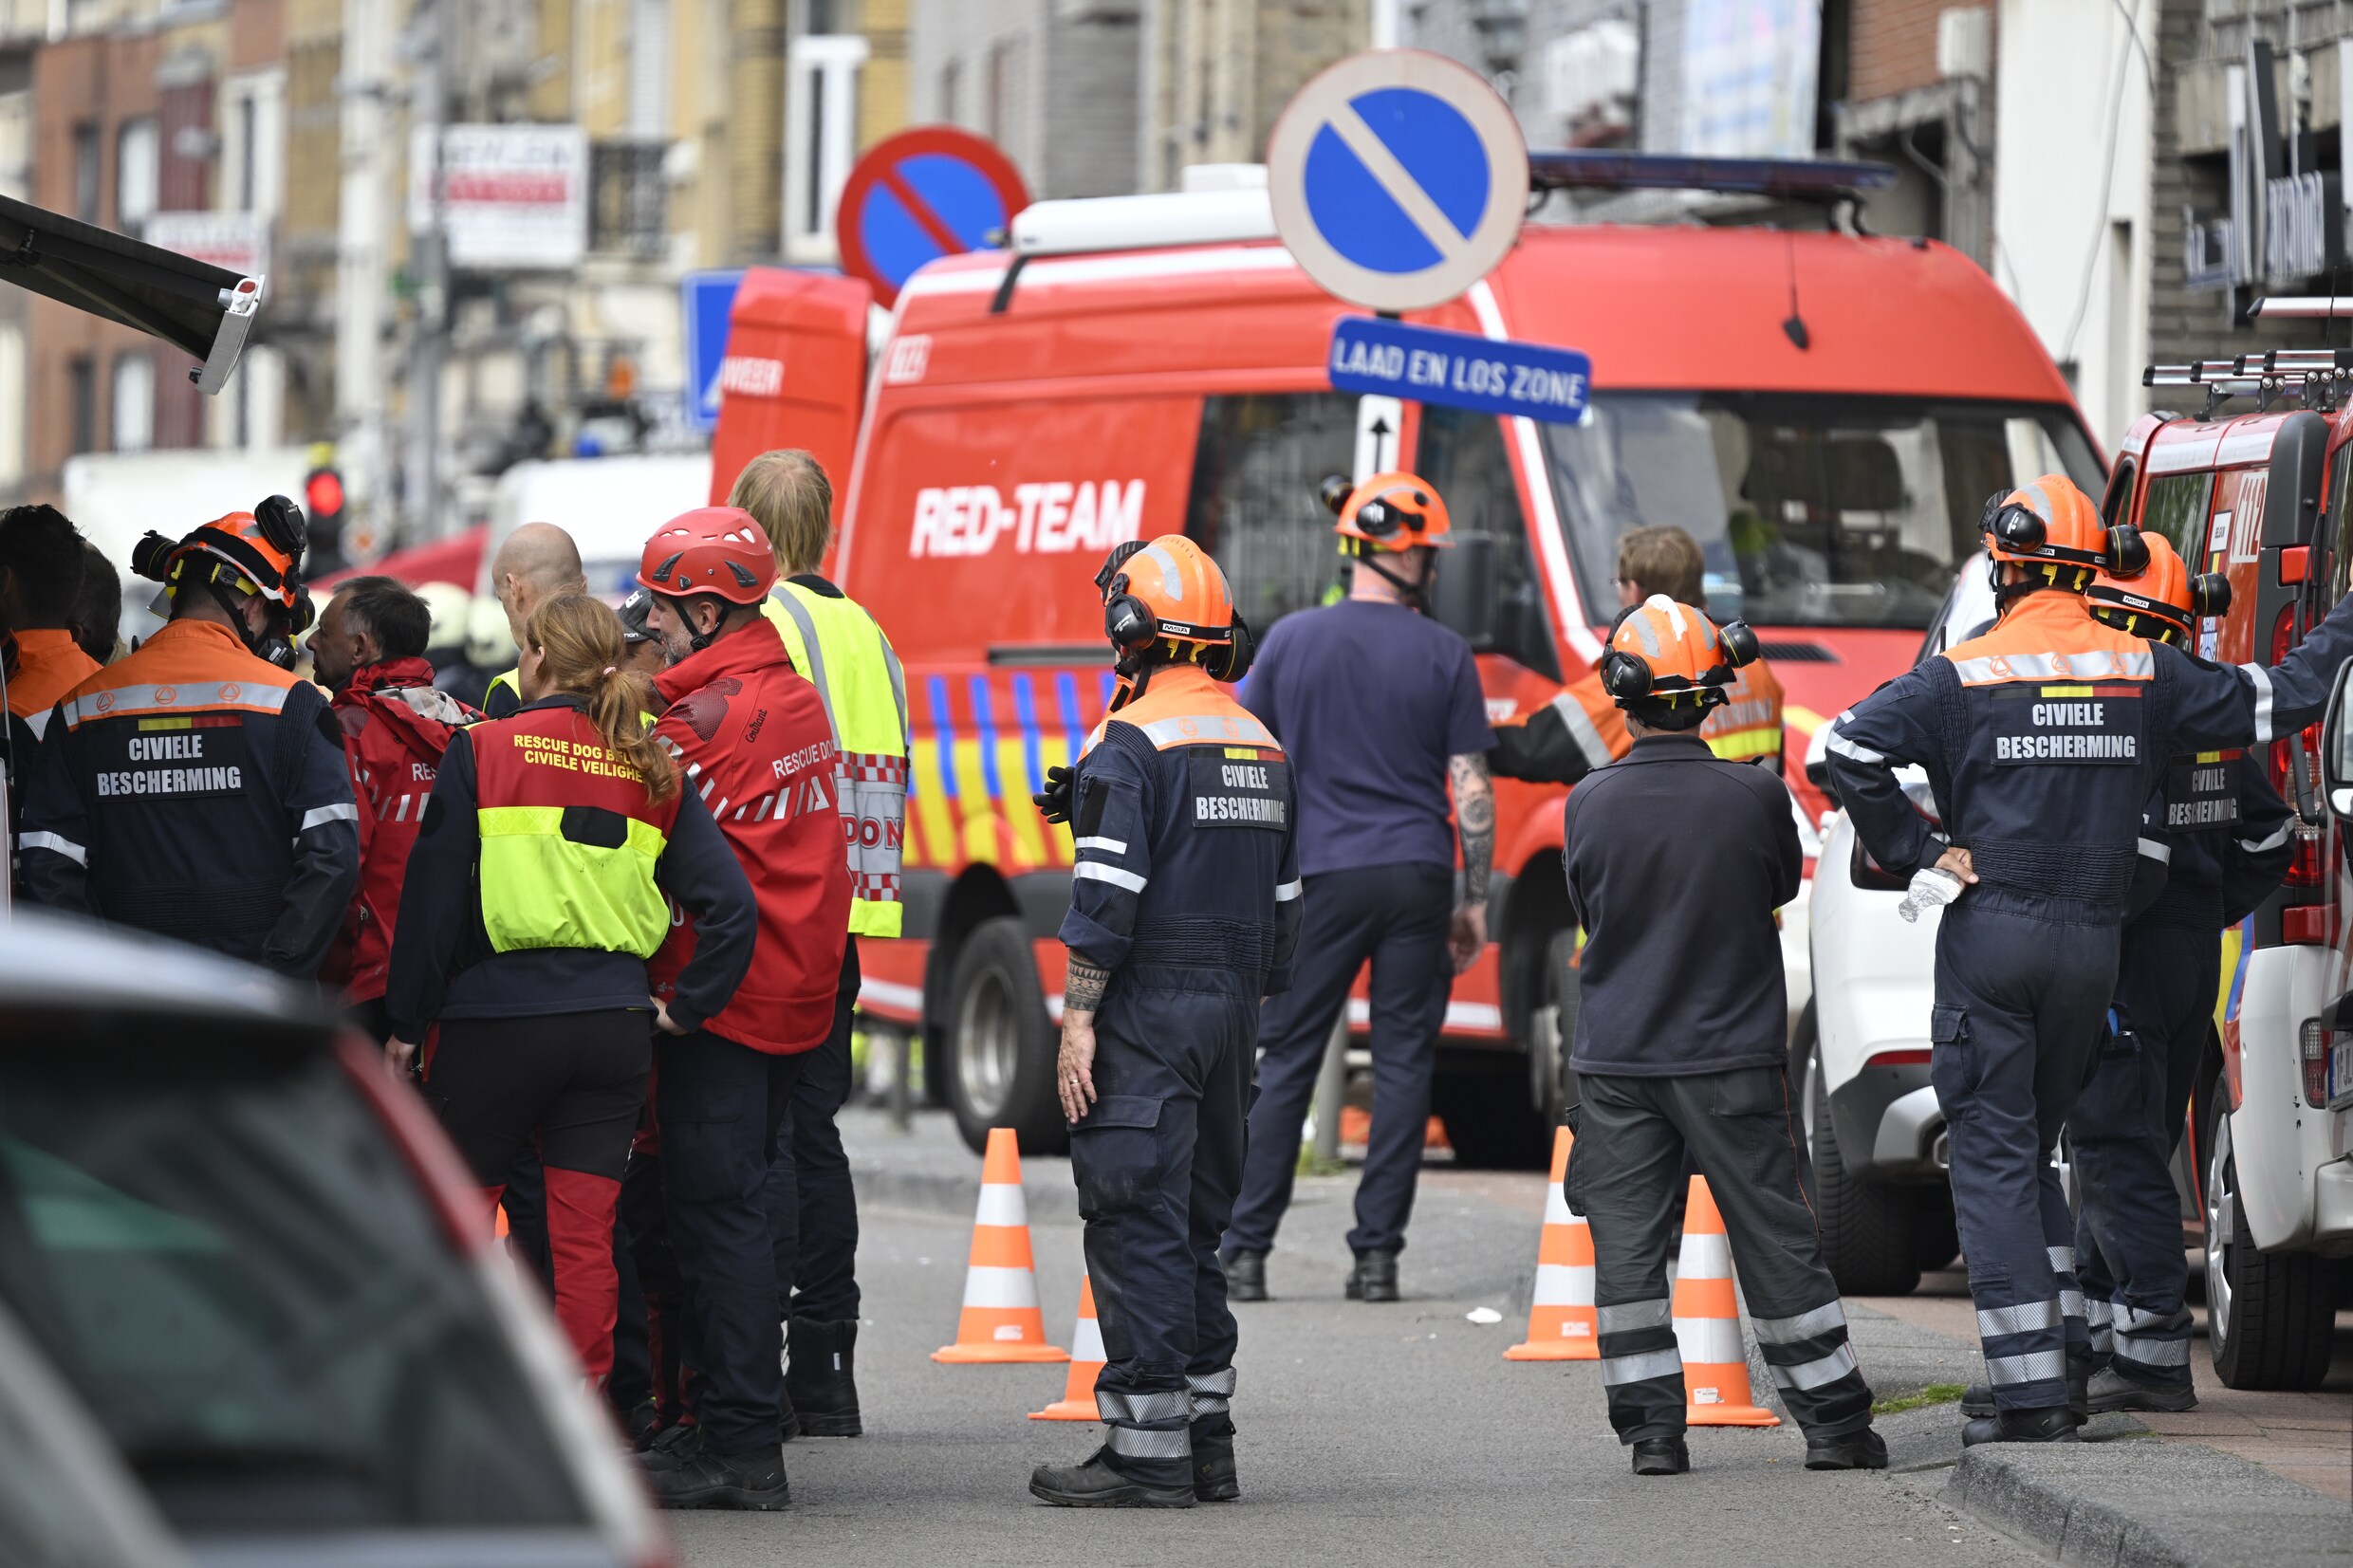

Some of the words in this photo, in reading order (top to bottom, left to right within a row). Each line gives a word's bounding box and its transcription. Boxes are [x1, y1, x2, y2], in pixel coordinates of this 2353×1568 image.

[1333, 338, 1405, 381] LAAD
[1407, 349, 1449, 388] EN
[1452, 356, 1509, 397] LOS
[1509, 364, 1586, 409] ZONE
[909, 478, 1146, 559] RED-TEAM
[1164, 624, 1189, 634] MSA
[2032, 703, 2104, 727] CIVIELE
[128, 734, 203, 762] CIVIELE
[513, 734, 569, 754] RESCUE
[572, 743, 602, 760] DOG
[1996, 735, 2136, 759] BESCHERMING
[525, 750, 578, 771] CIVIELE
[581, 759, 646, 784] VEILIGHE
[771, 744, 820, 779] RESCUE
[97, 766, 242, 797] BESCHERMING
[1221, 765, 1269, 789] CIVIELE
[1195, 797, 1285, 823] BESCHERMING
